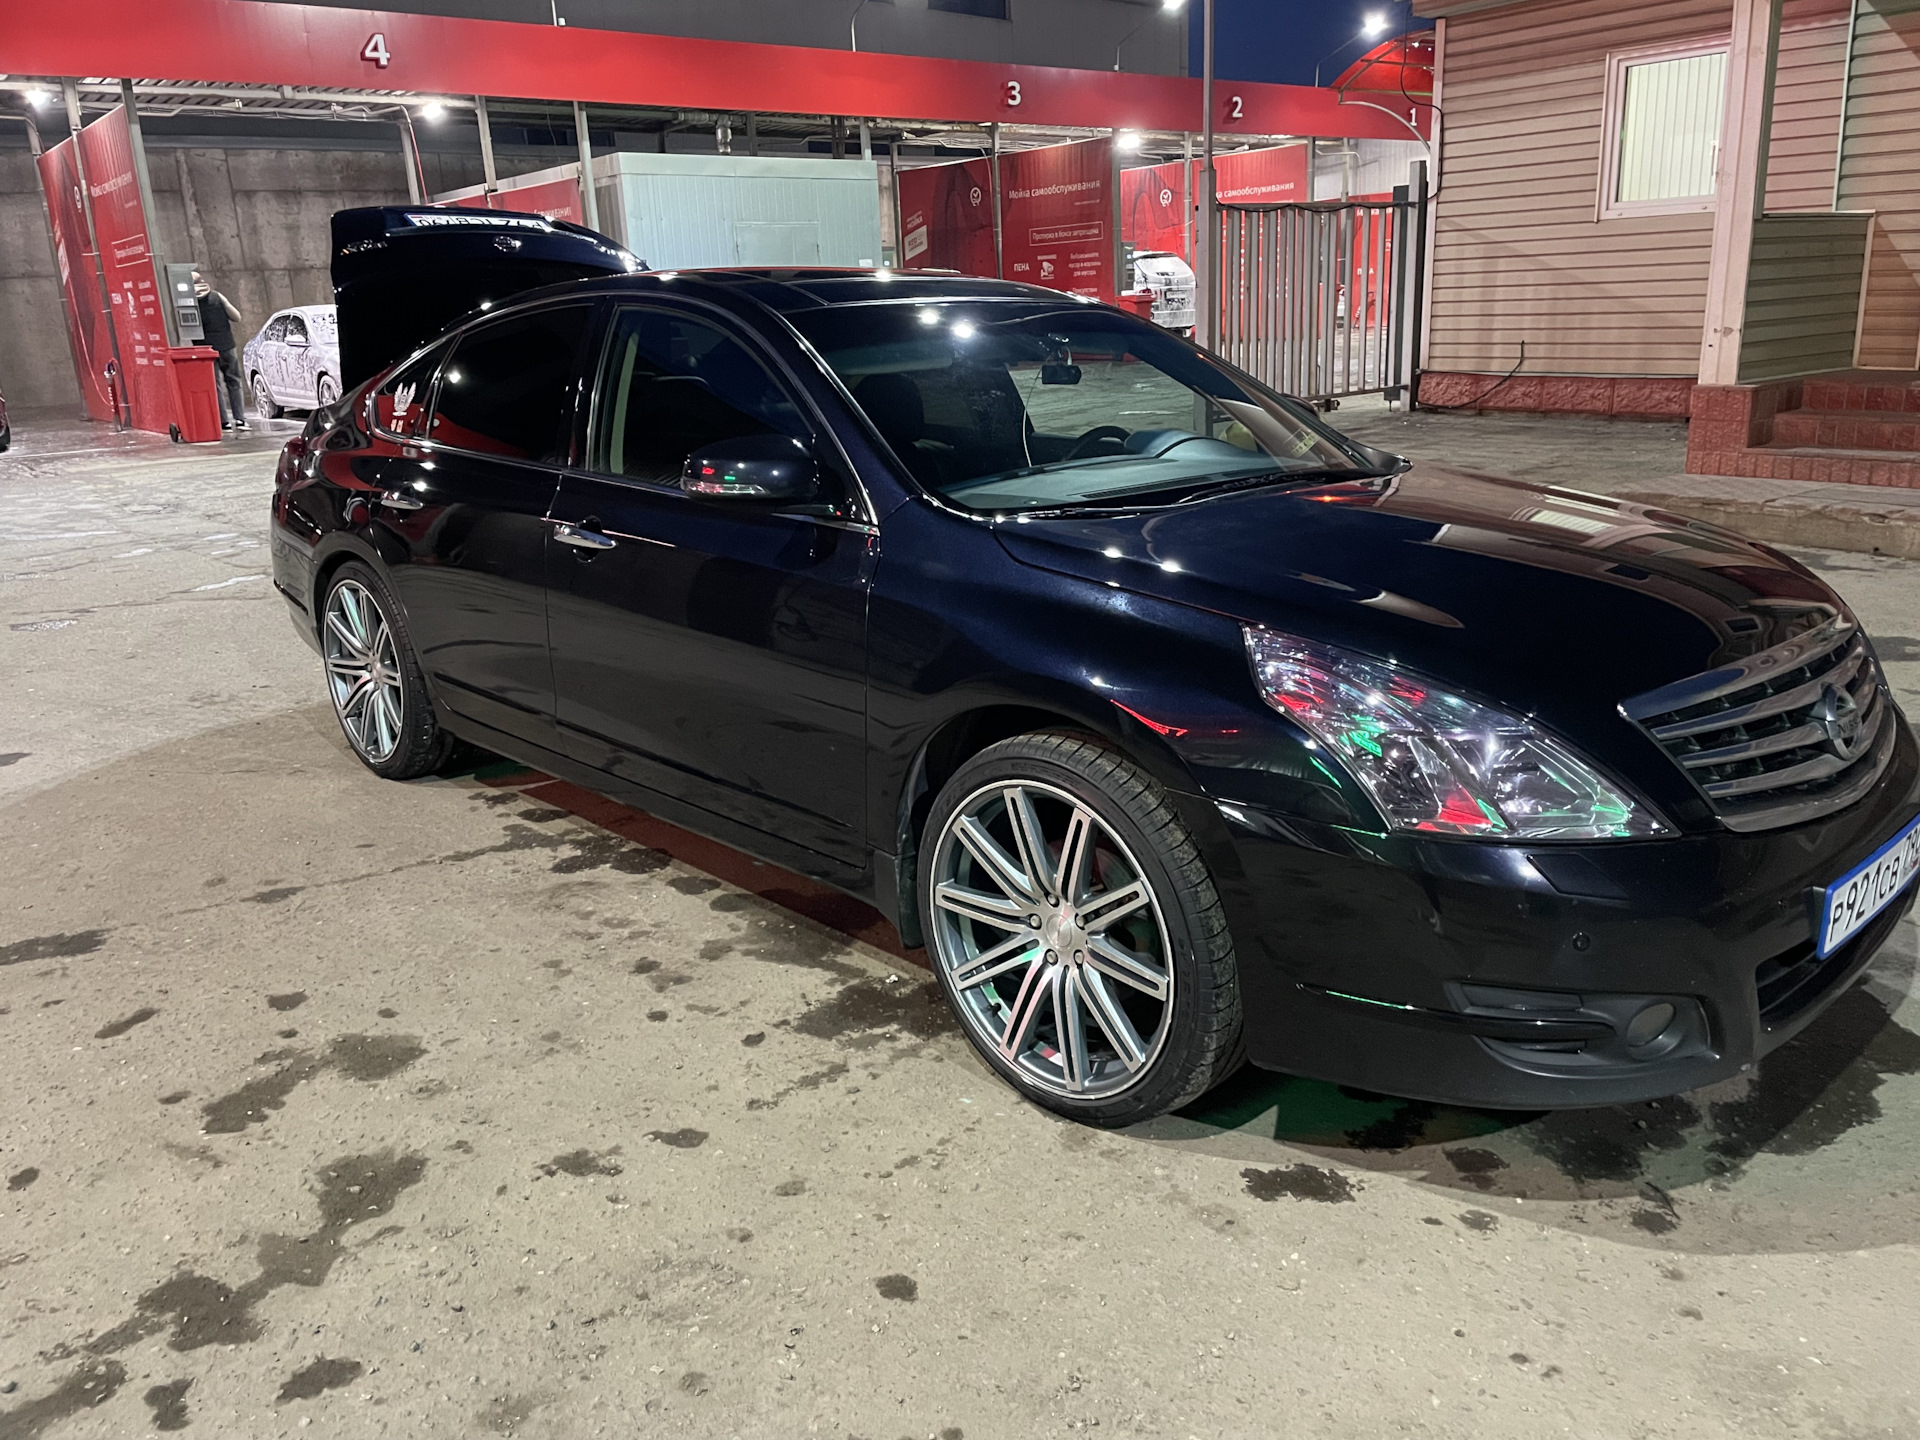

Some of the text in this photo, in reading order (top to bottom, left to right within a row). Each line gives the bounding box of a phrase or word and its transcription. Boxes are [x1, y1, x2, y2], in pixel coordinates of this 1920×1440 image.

[363, 33, 391, 67] 4
[1007, 80, 1022, 106] 3
[1232, 96, 1243, 118] 2
[1409, 107, 1418, 126] 1
[1008, 180, 1100, 199] Мойка самообслуживания
[1223, 182, 1295, 198] самообслуживания
[1013, 262, 1031, 272] ПЕНА
